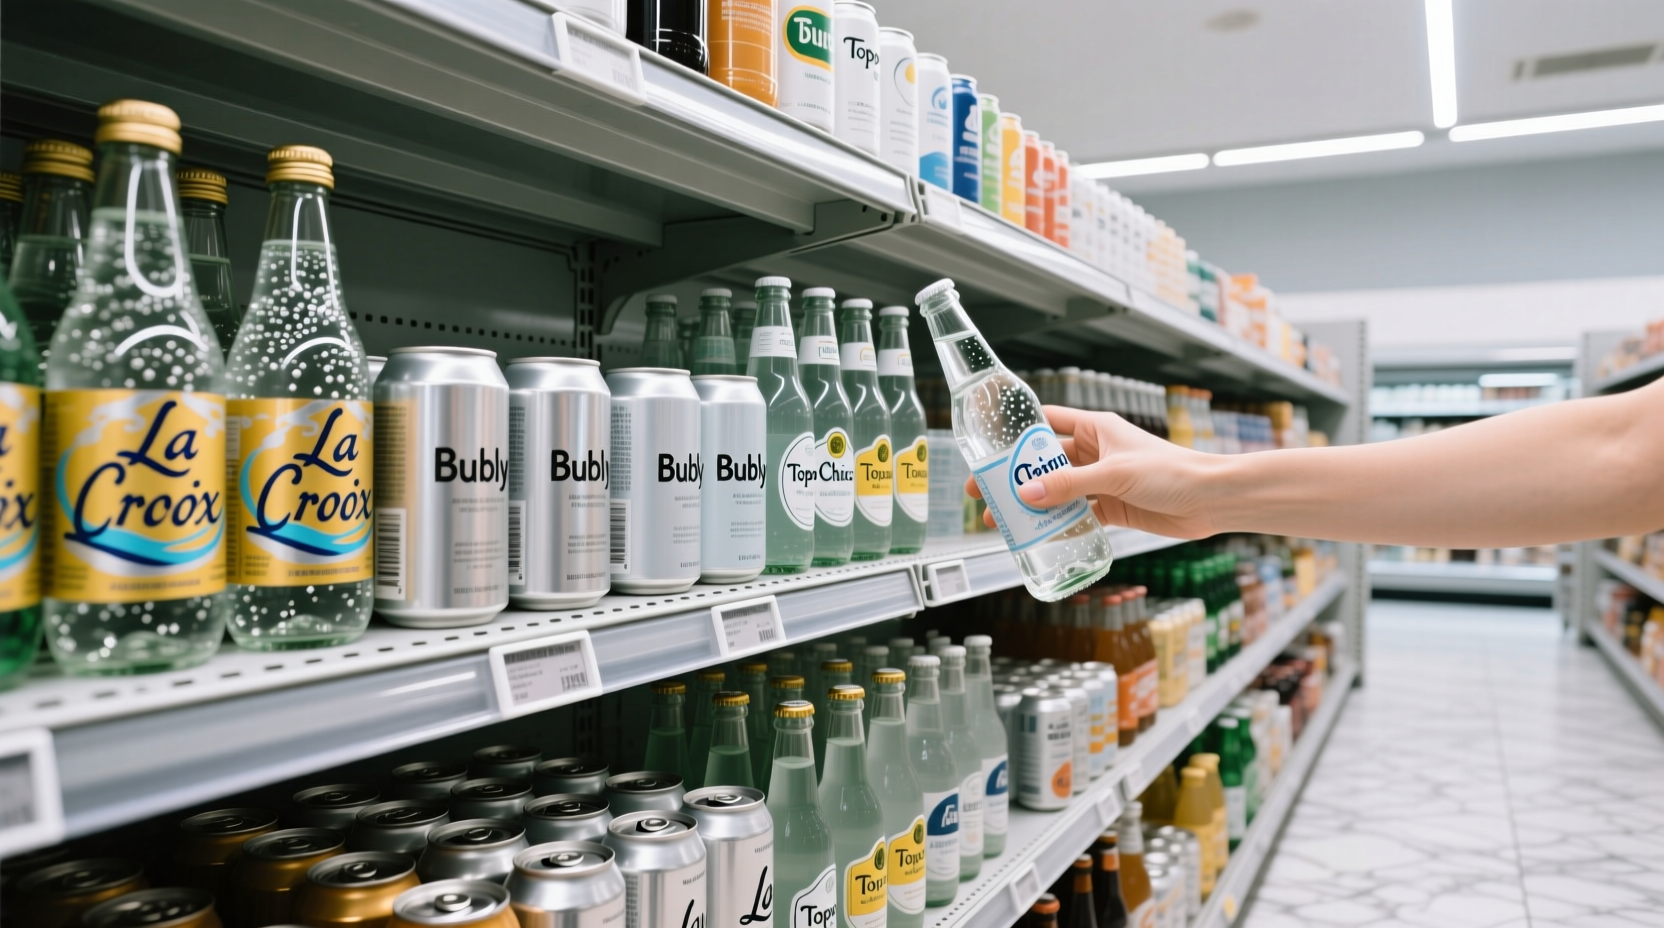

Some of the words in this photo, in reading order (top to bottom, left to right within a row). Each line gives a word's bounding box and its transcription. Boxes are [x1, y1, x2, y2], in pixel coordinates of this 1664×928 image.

[116, 400, 199, 478] La
[293, 407, 359, 478] La
[435, 446, 508, 492] Bubly
